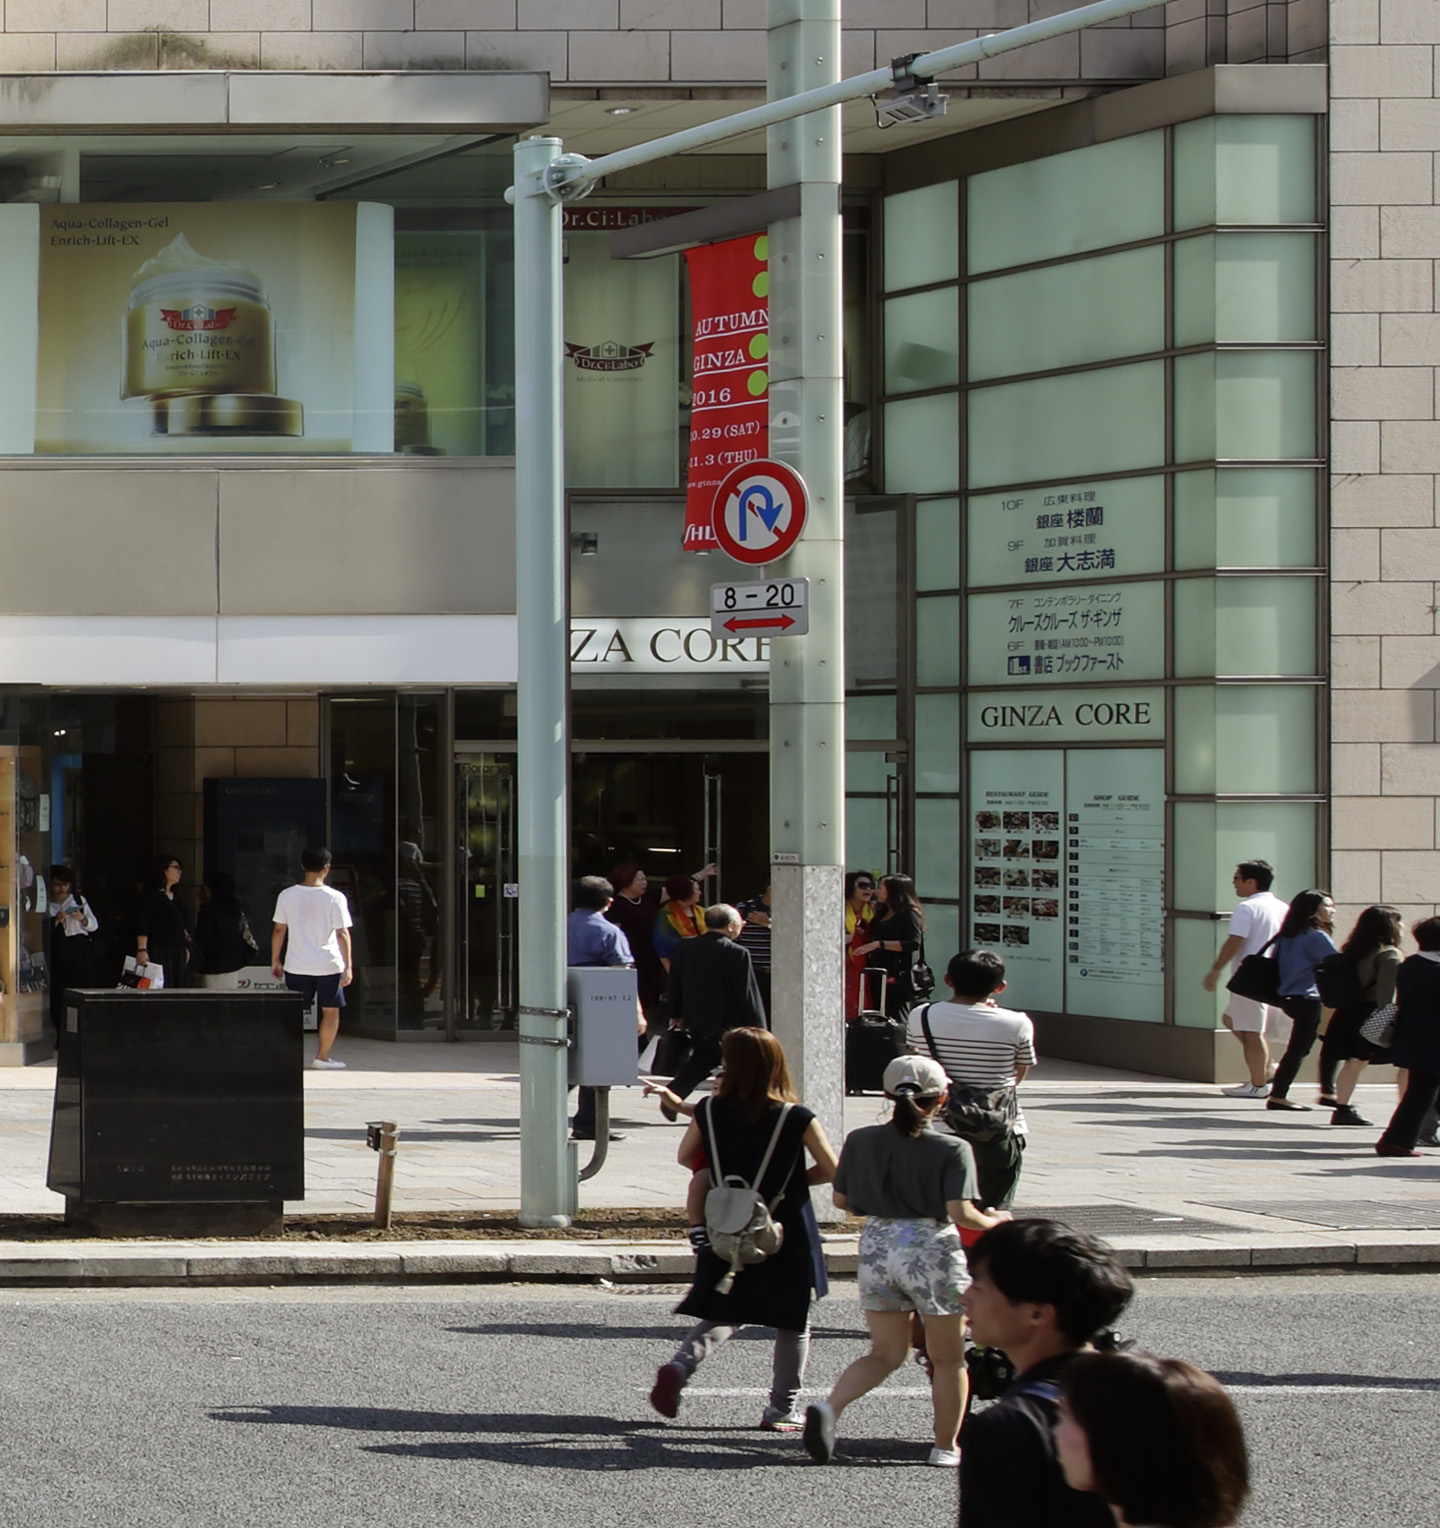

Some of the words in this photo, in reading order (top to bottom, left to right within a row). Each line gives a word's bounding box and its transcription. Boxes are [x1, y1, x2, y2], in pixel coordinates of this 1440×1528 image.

[51, 216, 169, 231] Aqua-Collagen-Gel
[695, 308, 769, 337] AUTUMN
[693, 348, 746, 371] GINZA
[690, 420, 761, 442] 0.29(SAT)
[981, 706, 1063, 728] GINZA
[1075, 702, 1151, 726] CORE
